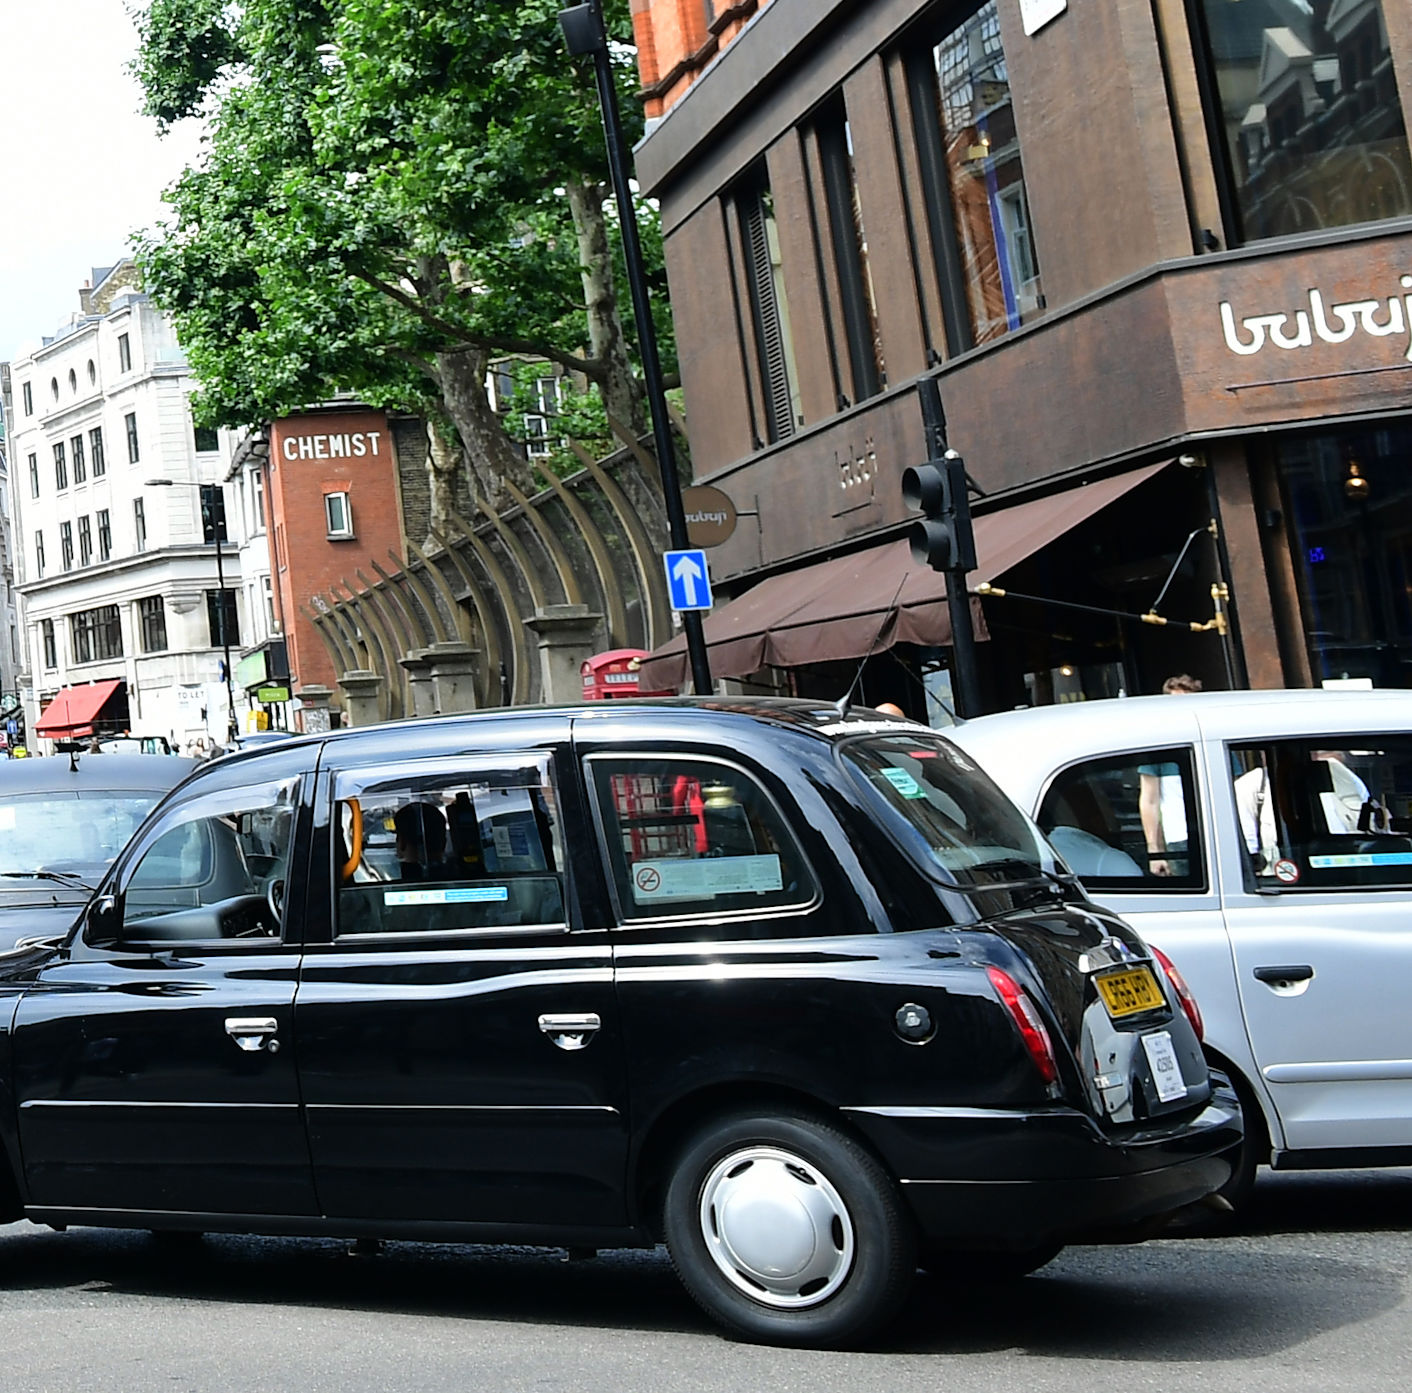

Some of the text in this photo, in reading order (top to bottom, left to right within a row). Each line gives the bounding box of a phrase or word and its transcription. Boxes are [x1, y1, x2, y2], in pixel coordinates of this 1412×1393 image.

[1220, 273, 1412, 363] babaj
[283, 431, 381, 461] CHEMIST
[604, 672, 640, 684] TELEP
